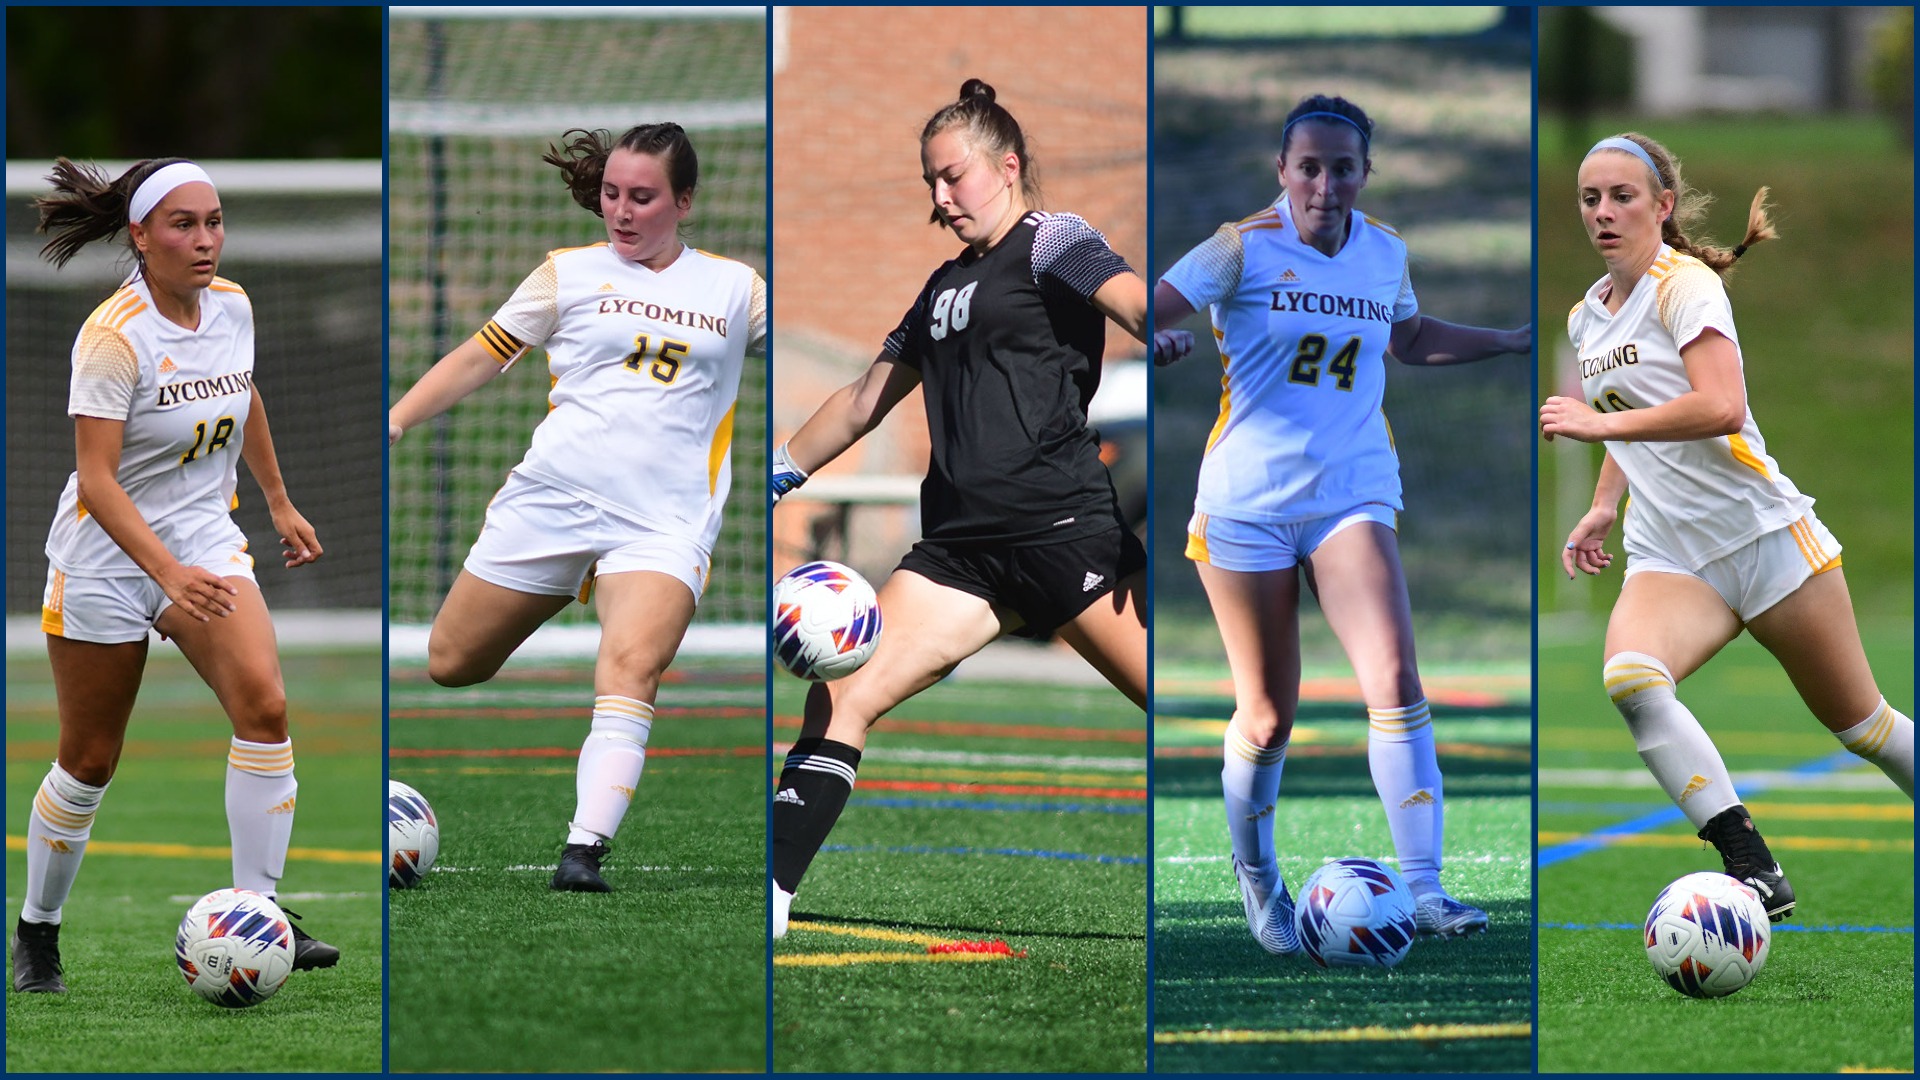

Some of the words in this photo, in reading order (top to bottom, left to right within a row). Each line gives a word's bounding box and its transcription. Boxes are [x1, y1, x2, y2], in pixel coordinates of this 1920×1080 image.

[598, 299, 727, 339] LYCOMING
[930, 280, 979, 342] 98
[623, 332, 692, 387] 15
[1287, 332, 1362, 393] 24
[1579, 343, 1640, 381] COMING
[179, 415, 238, 466] 18
